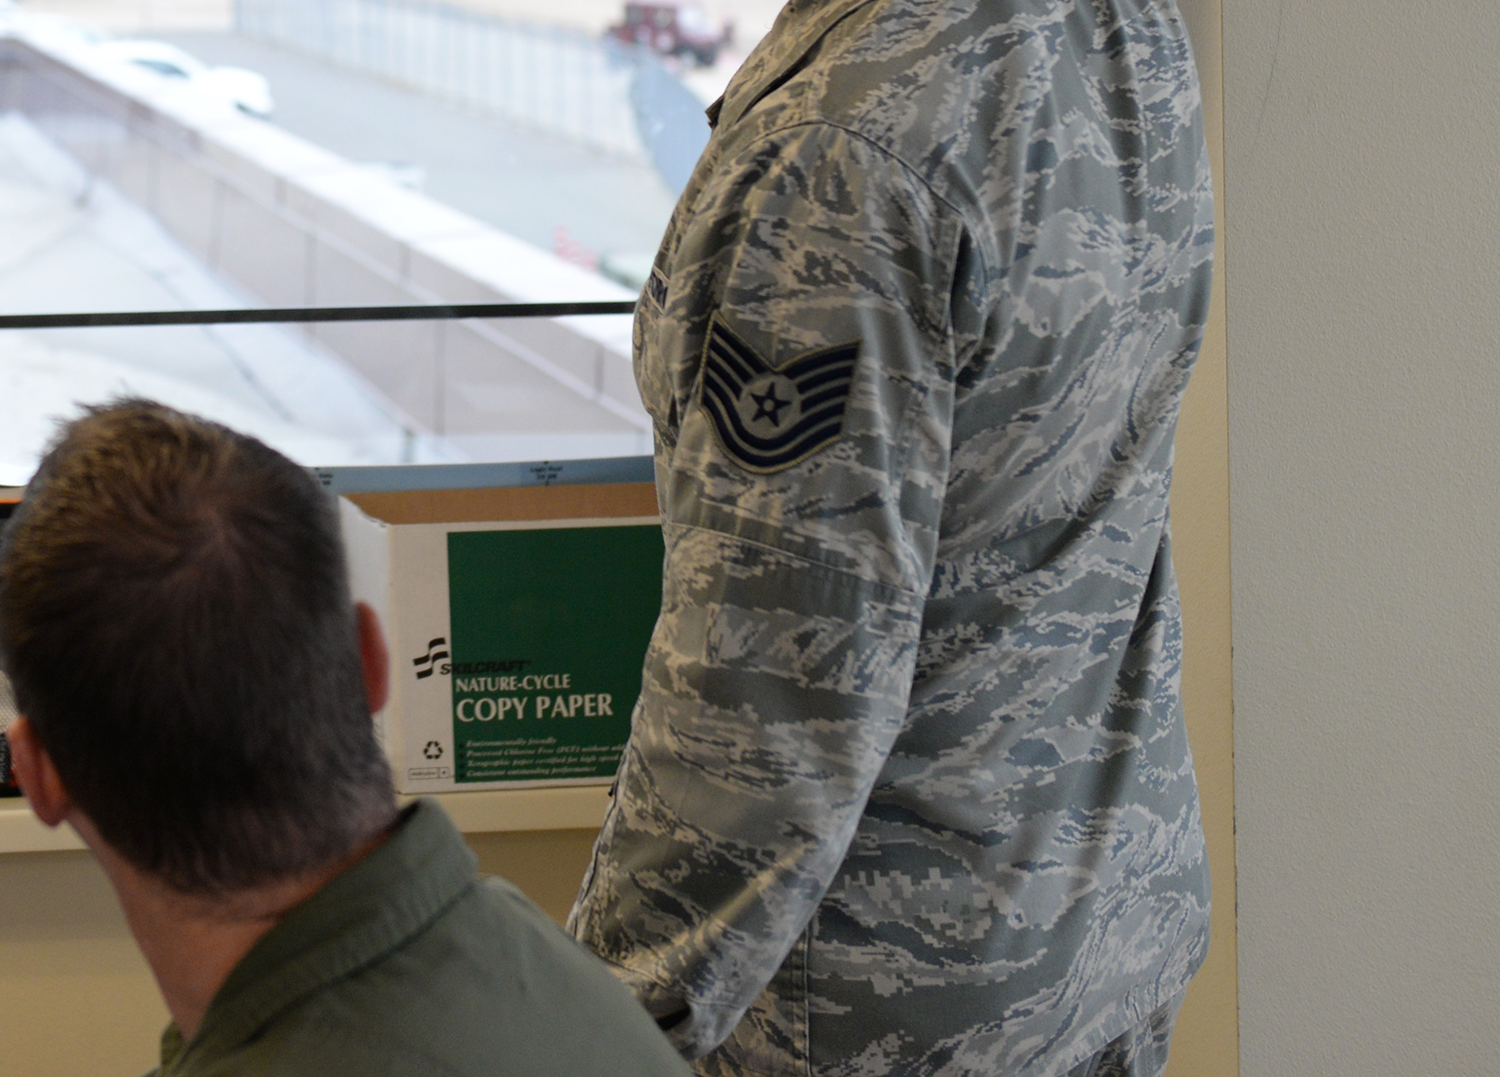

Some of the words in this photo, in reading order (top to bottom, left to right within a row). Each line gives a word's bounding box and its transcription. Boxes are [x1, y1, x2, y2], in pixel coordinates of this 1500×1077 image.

[440, 660, 525, 675] SKILCRAFT
[456, 674, 571, 692] NATURE-CYCLE
[456, 697, 528, 721] COPY
[536, 694, 613, 718] PAPER
